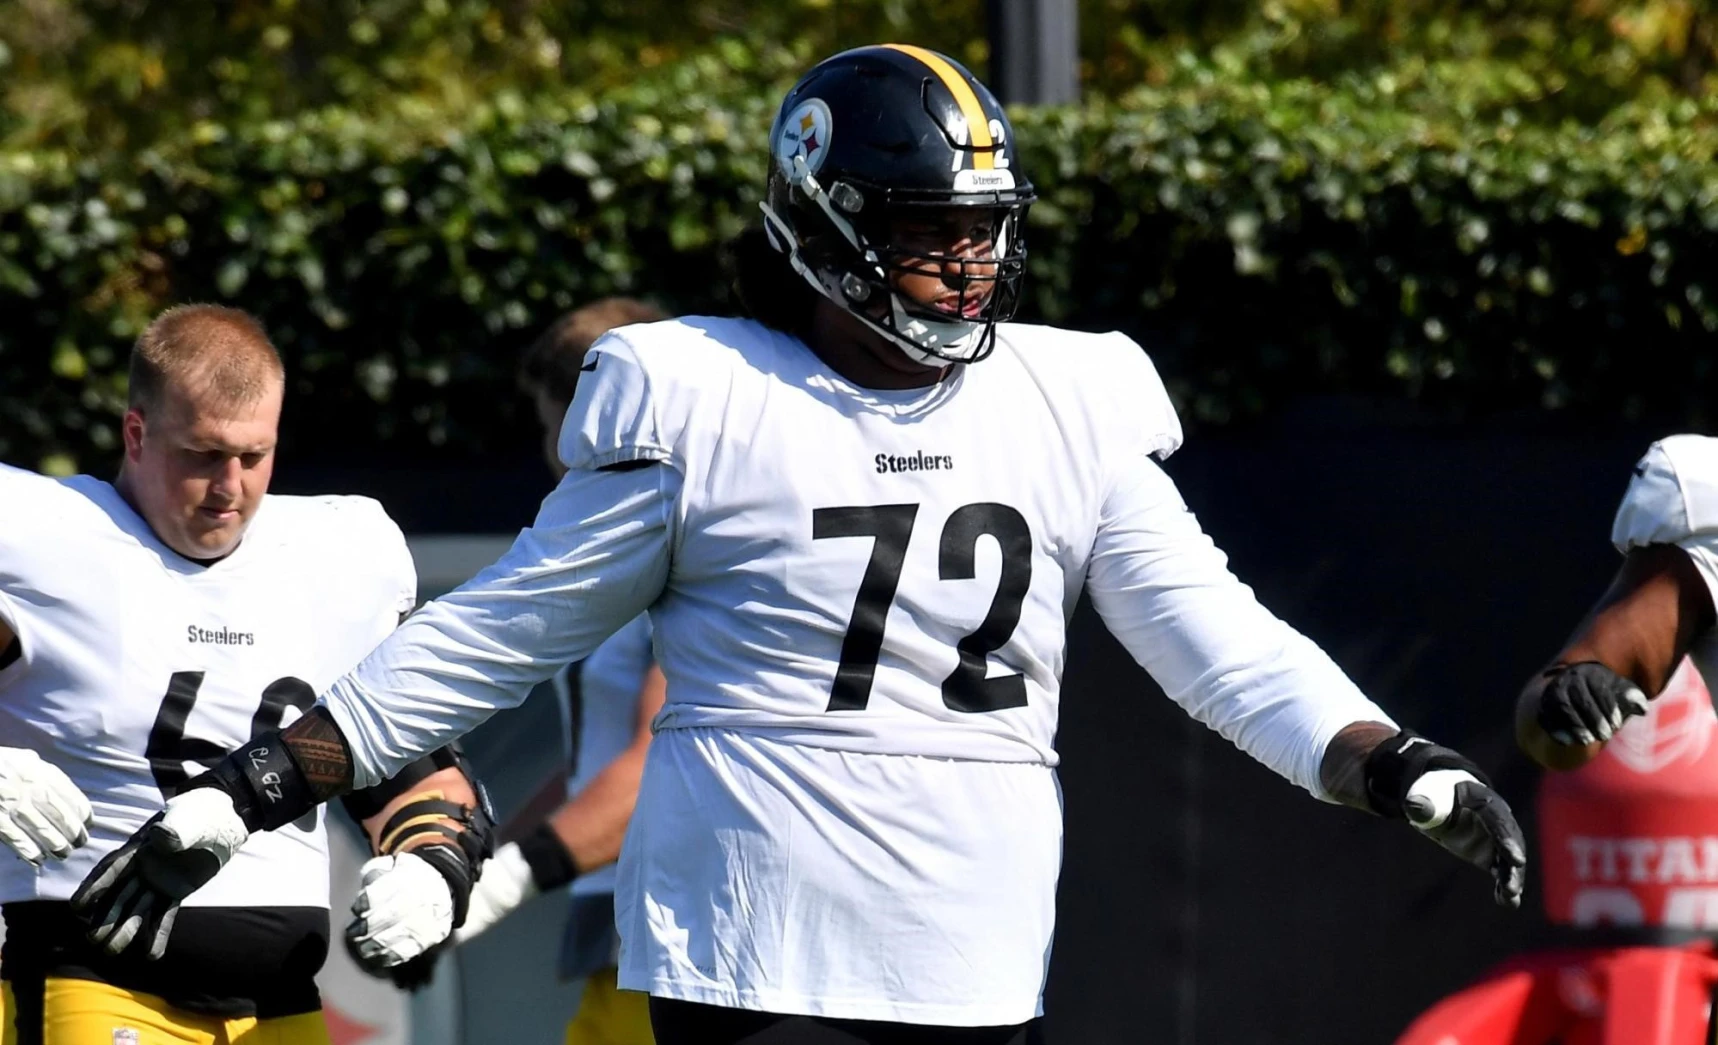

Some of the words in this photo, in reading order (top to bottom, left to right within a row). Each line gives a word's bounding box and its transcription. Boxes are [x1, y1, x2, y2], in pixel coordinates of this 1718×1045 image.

[874, 450, 954, 474] Steelers
[812, 502, 1032, 713] 72
[187, 625, 255, 646] Steelers
